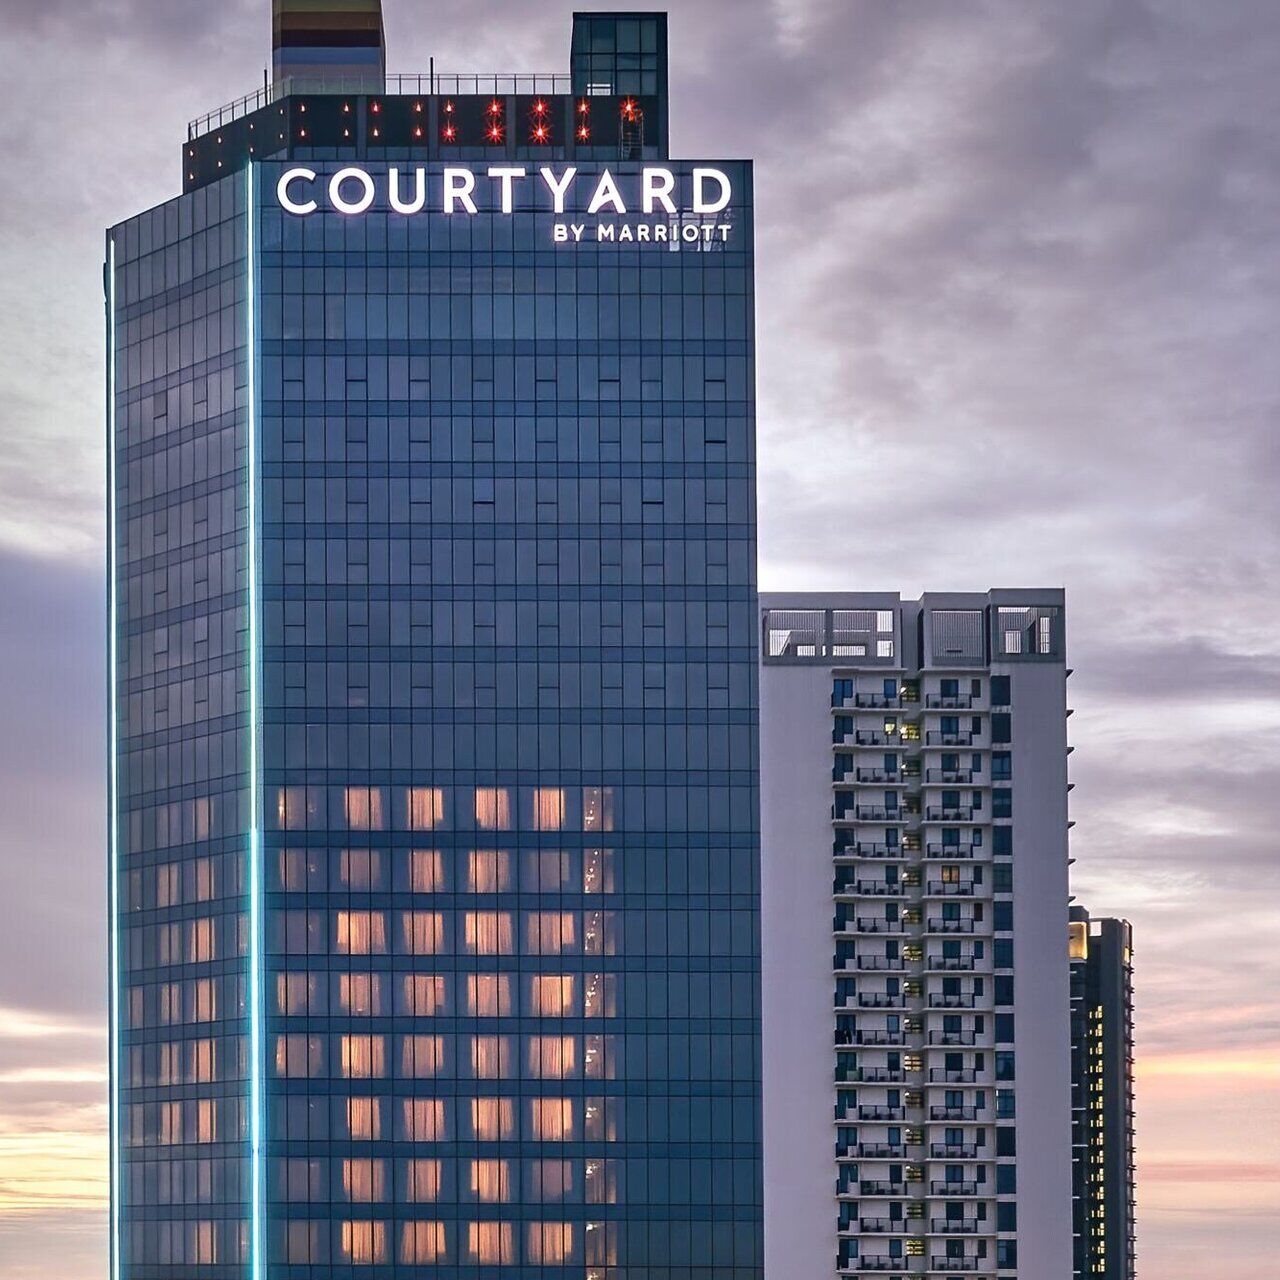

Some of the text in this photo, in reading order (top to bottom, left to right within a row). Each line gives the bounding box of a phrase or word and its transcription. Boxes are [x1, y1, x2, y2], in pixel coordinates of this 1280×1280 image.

[276, 167, 732, 215] COURTYARD
[553, 223, 732, 242] BY MARRIOTT
